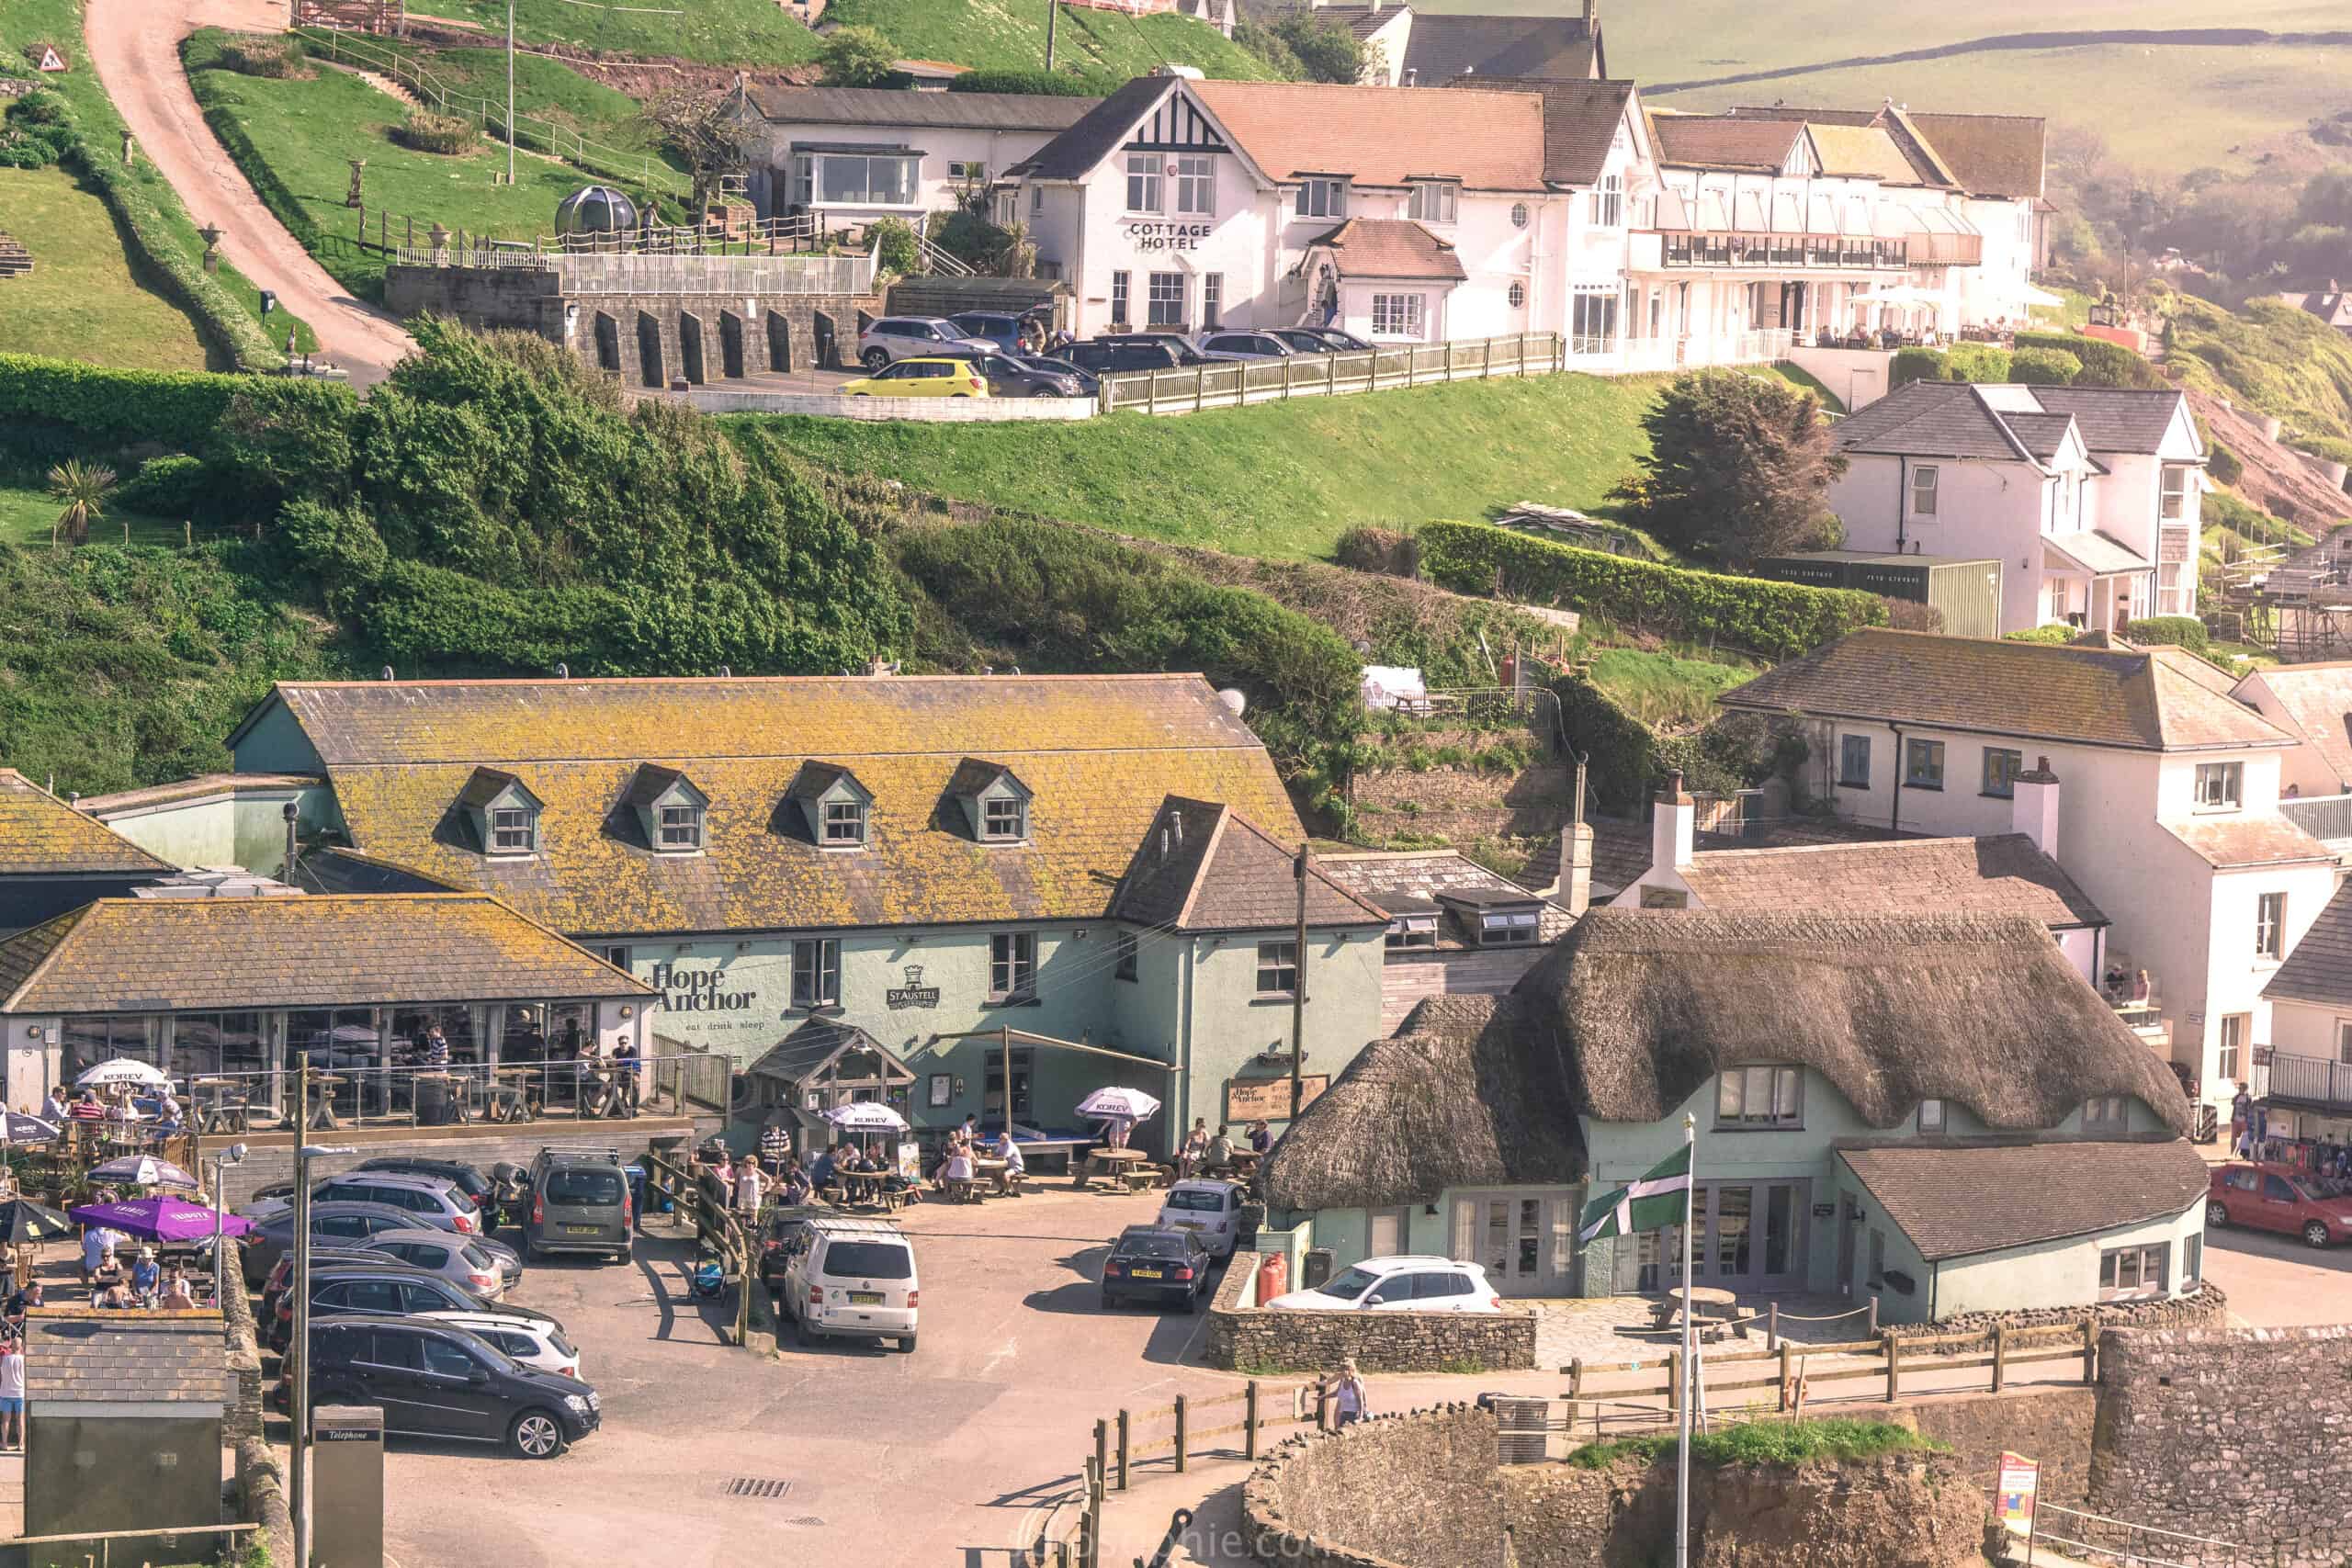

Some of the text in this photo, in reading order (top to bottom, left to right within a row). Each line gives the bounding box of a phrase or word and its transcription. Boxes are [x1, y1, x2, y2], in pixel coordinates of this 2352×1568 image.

[1130, 223, 1211, 236] COTTAGE
[1142, 237, 1198, 250] HOTEL
[652, 963, 725, 996] Hope
[653, 986, 756, 1011] Anchor
[685, 1021, 764, 1031] eat drink sleep
[103, 1073, 143, 1081] KOREV
[1096, 1103, 1128, 1112] KOREV
[329, 1431, 368, 1440] Telephone
